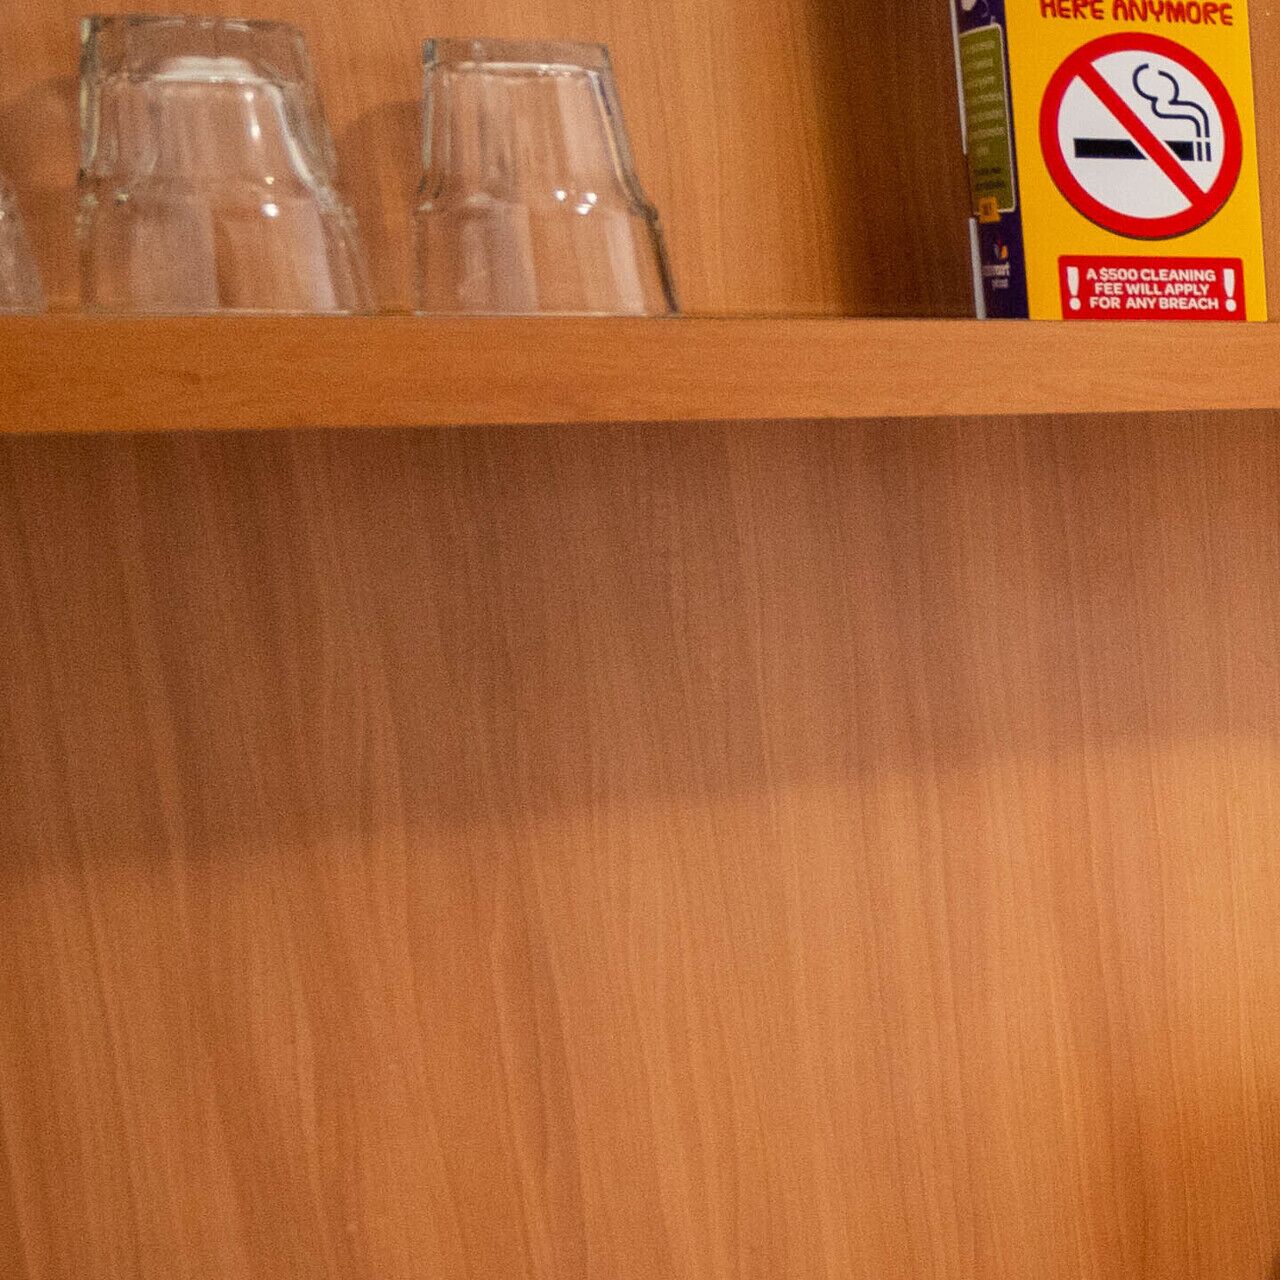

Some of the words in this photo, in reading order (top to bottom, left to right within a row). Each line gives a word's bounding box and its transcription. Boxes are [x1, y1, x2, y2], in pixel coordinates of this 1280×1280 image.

[1039, 0, 1105, 20] HERE
[1112, 0, 1234, 26] ANYMORE
[1086, 268, 1098, 281] A
[1101, 266, 1138, 282] $500
[1140, 269, 1217, 282] CLEANING
[1094, 282, 1124, 295] FEE
[1126, 283, 1162, 296] WILL
[1164, 283, 1210, 296] APPLY
[1090, 296, 1121, 310] FOR
[1125, 297, 1156, 310] ANY
[1159, 297, 1219, 310] BREACH
